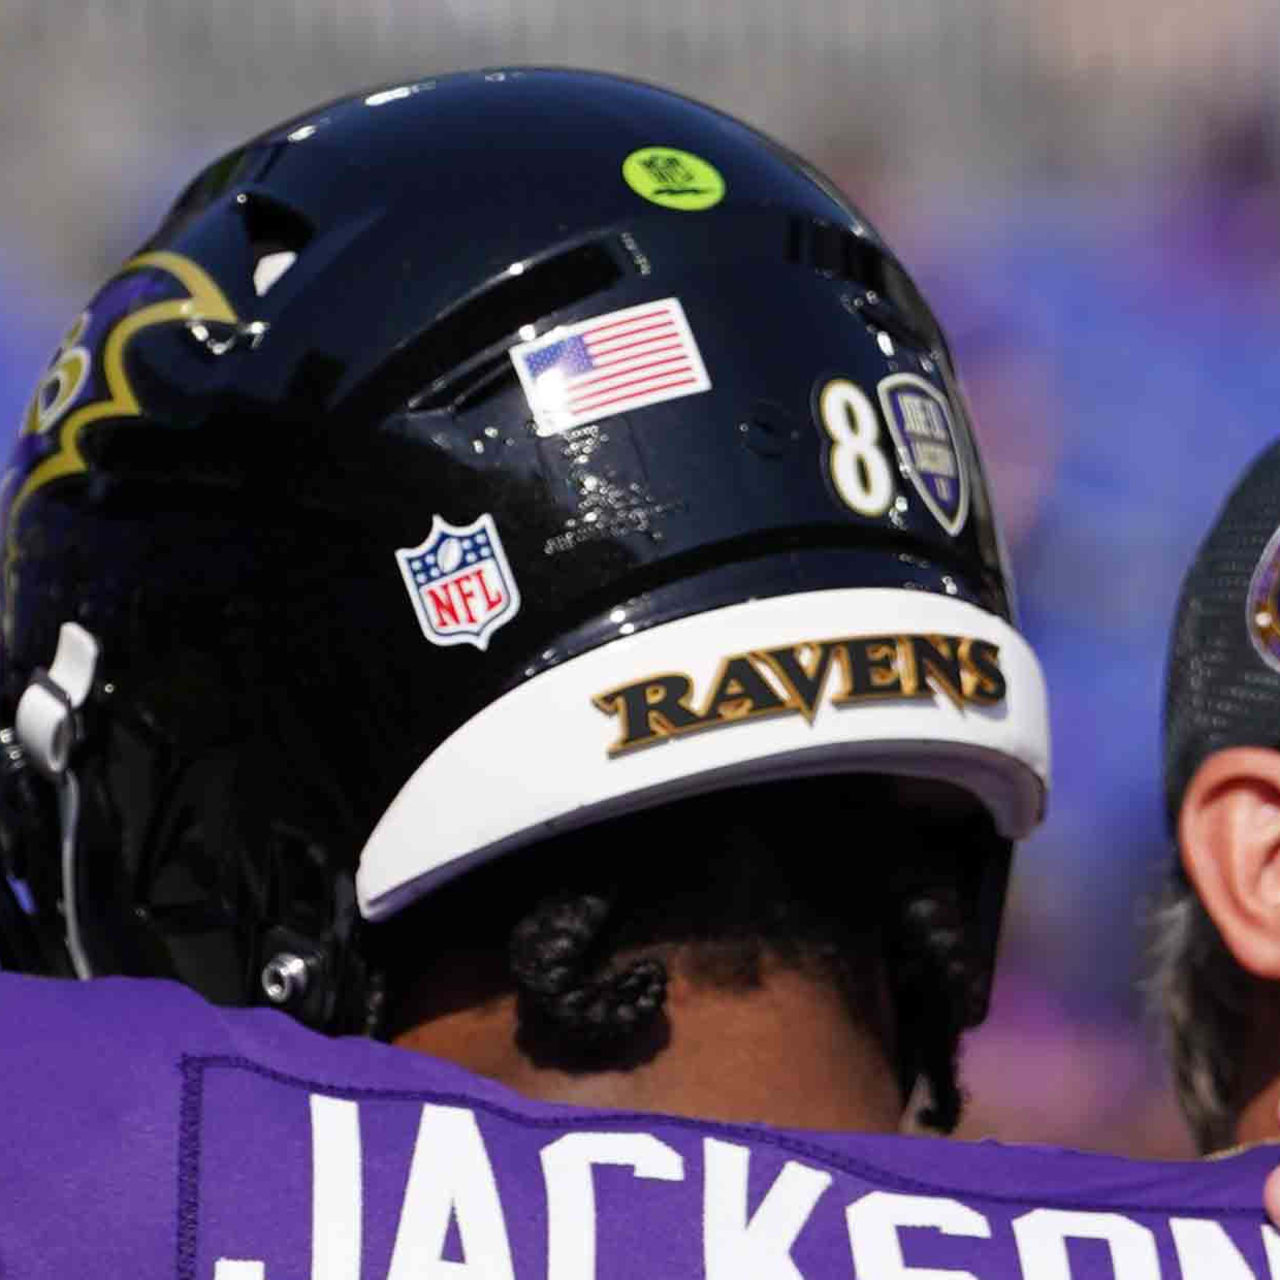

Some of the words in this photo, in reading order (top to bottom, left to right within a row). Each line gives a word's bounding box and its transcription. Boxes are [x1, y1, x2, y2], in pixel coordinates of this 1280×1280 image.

[821, 378, 892, 517] 8
[426, 569, 503, 628] NFL
[591, 633, 1009, 760] RAVENS
